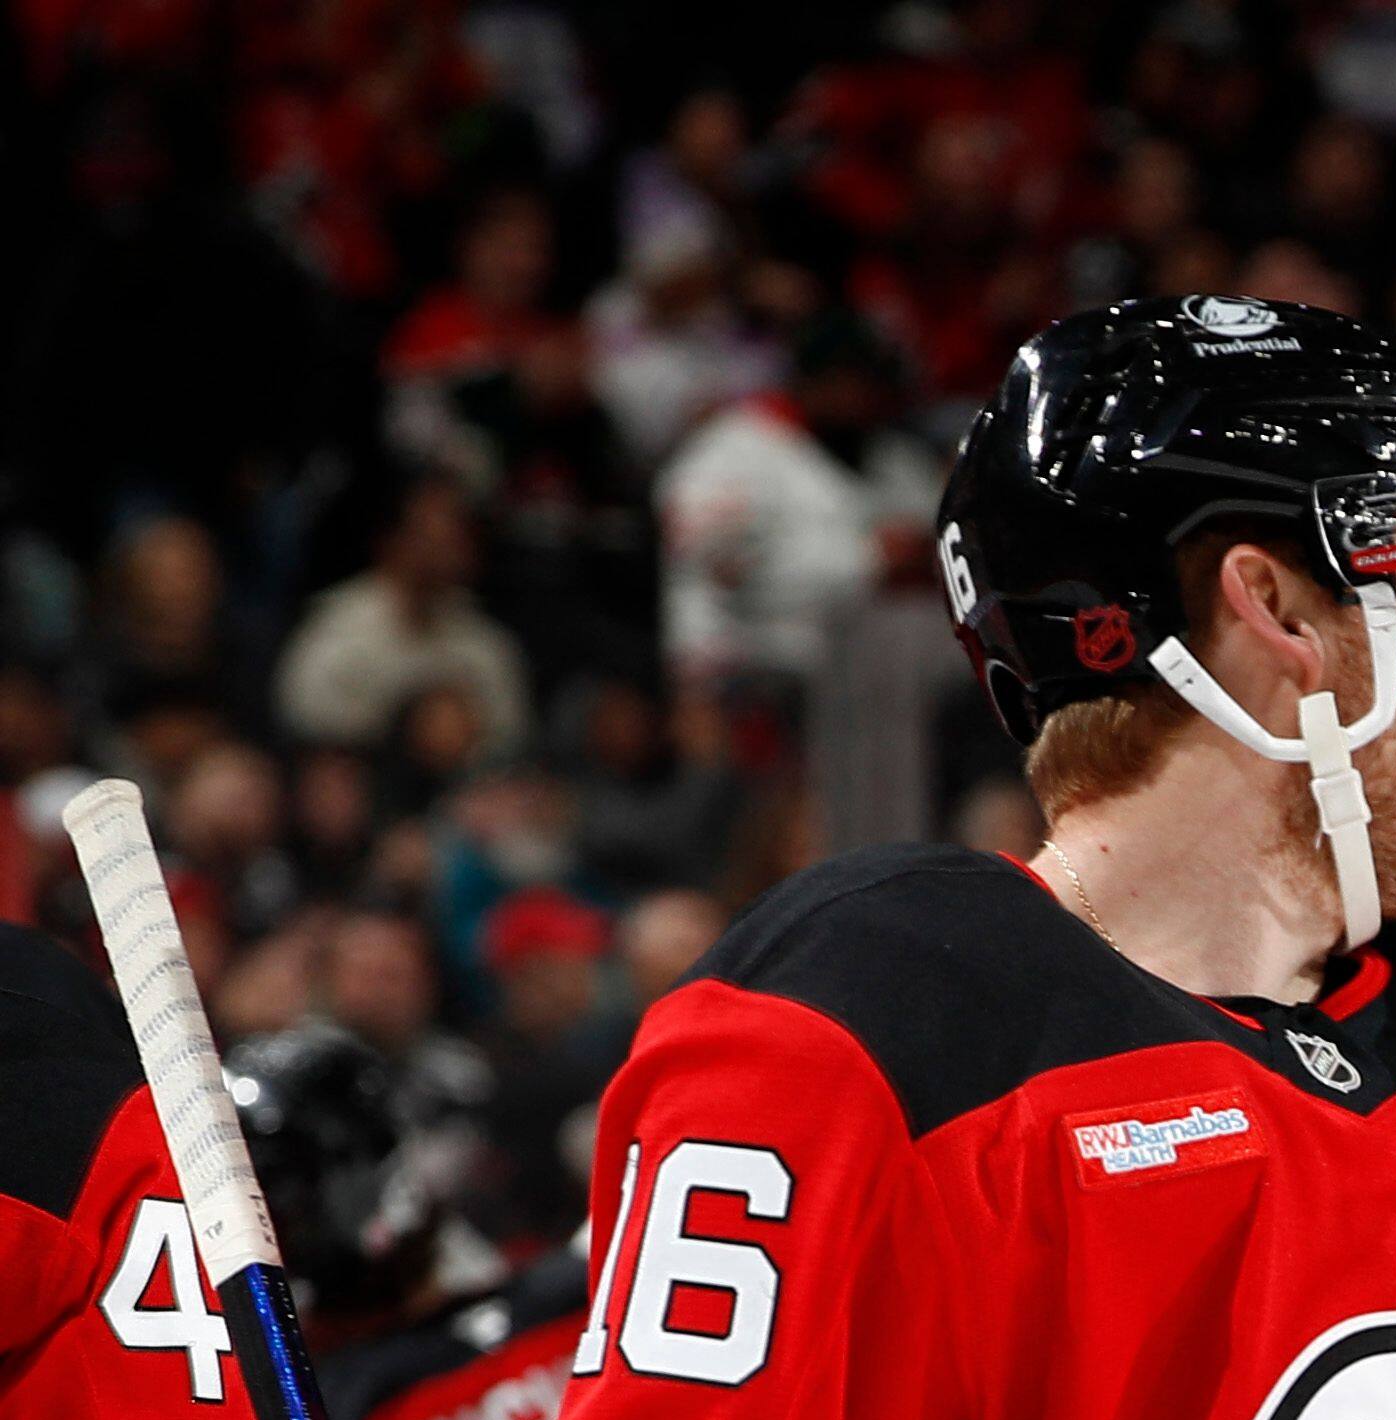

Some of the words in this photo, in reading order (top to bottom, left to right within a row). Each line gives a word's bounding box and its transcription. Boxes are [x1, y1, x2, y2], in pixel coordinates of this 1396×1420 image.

[1194, 337, 1302, 357] Prudential
[1074, 1107, 1249, 1160] RWJBarnabas
[1104, 1143, 1177, 1174] HEALTH
